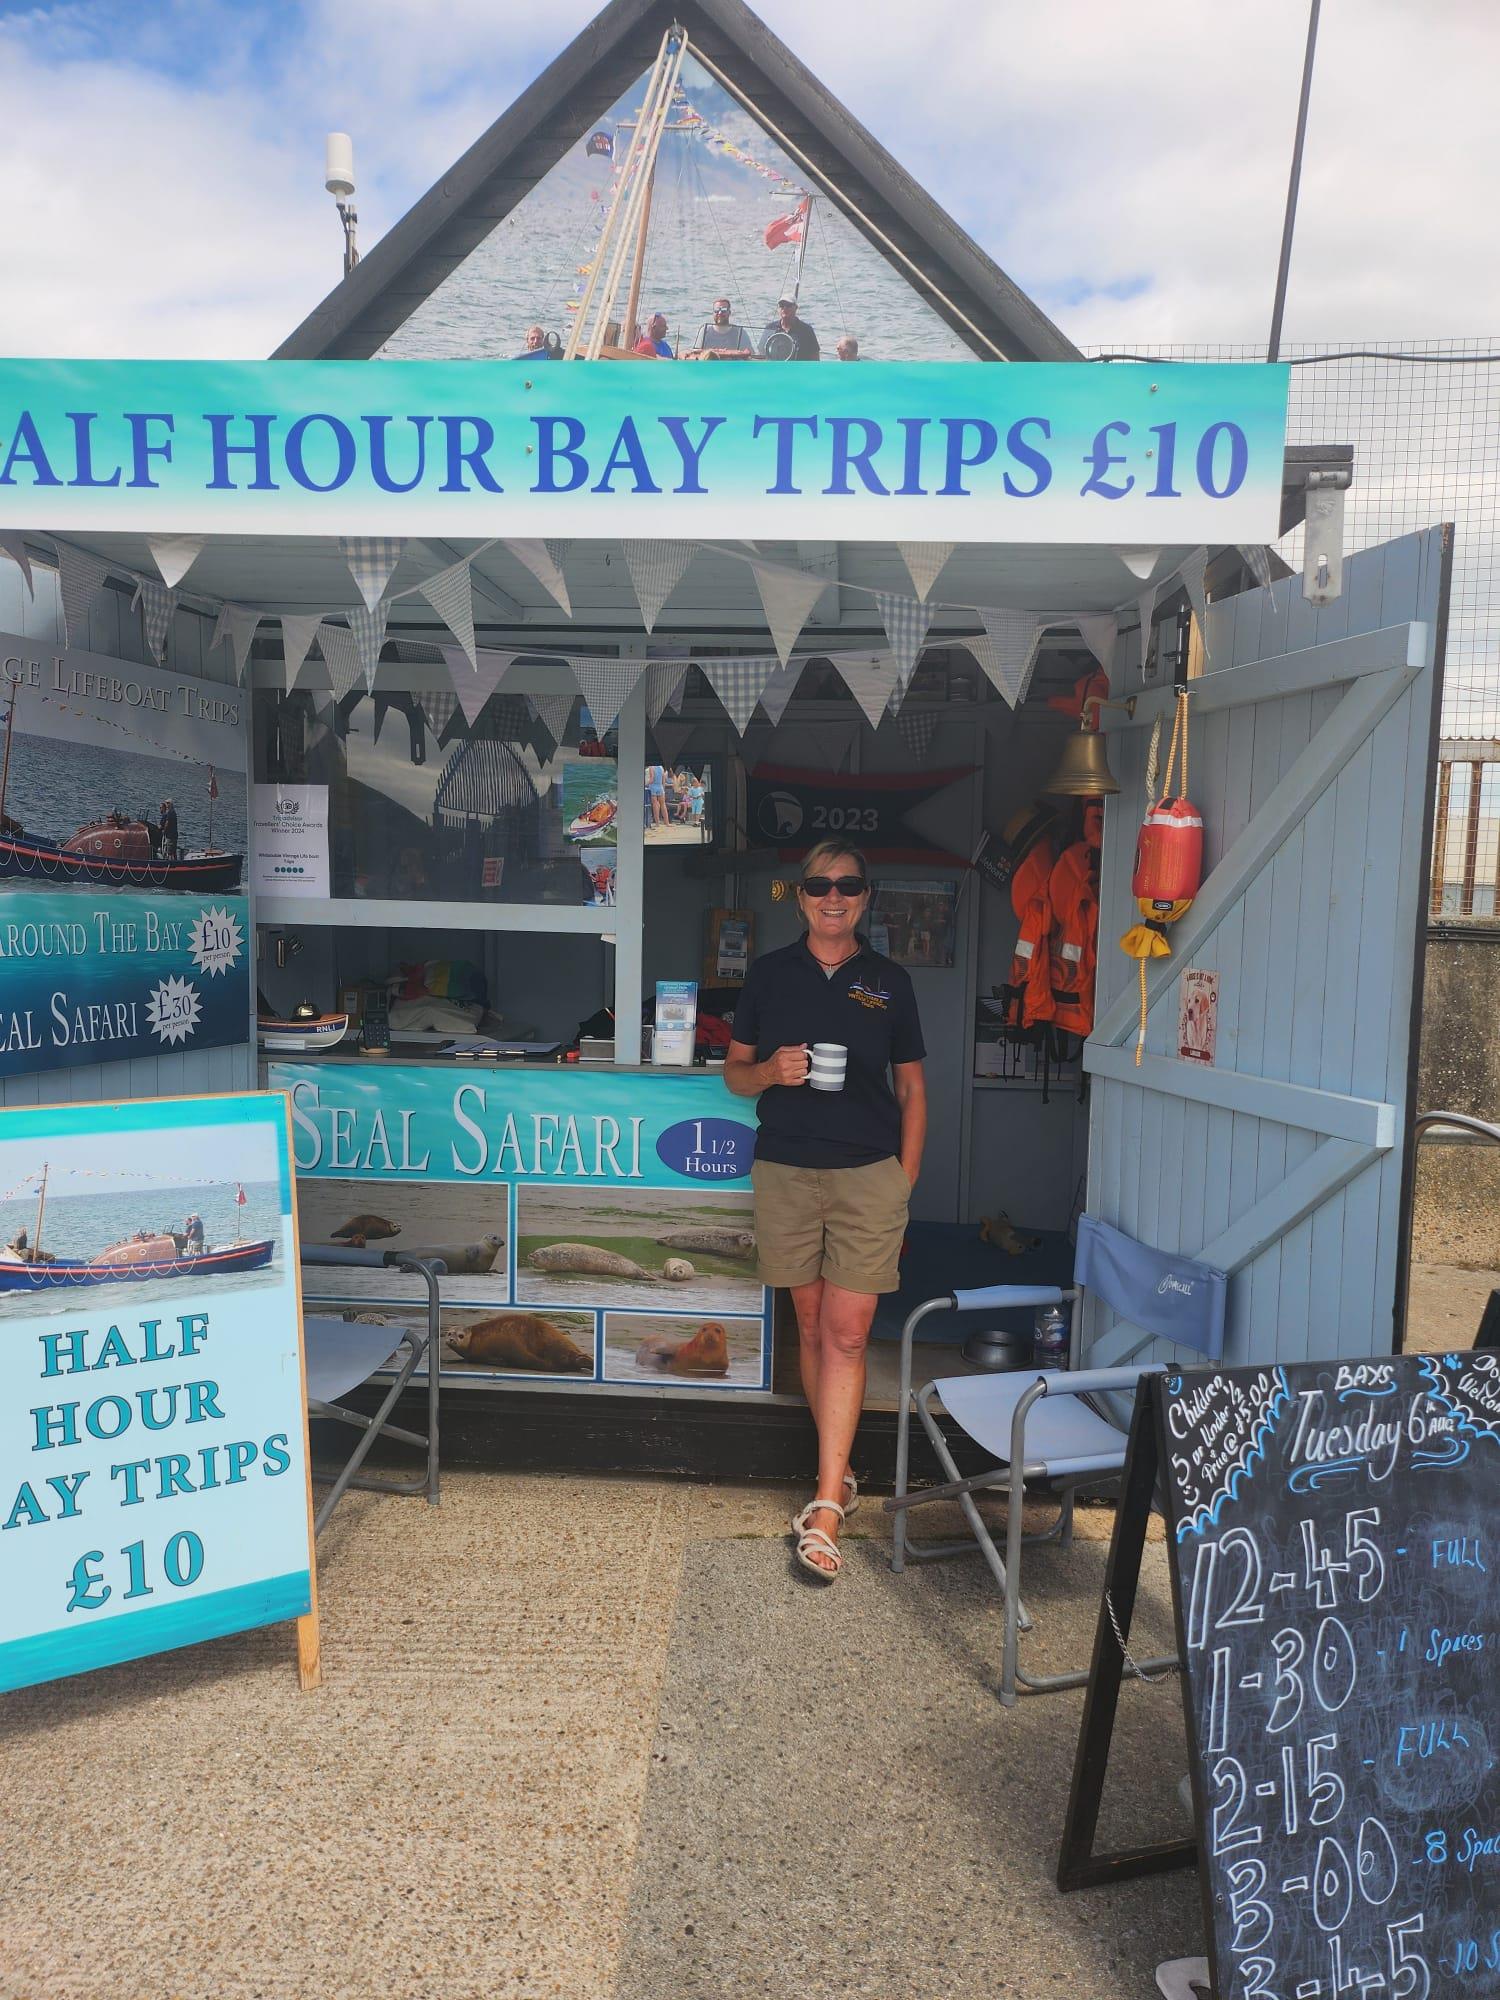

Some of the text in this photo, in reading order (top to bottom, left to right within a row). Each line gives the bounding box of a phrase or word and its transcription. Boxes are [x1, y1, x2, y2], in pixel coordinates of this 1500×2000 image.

[0, 409, 1249, 500] ALF HOUR BAY TRIPS £10
[0, 656, 41, 687] GE
[811, 806, 880, 832] 2023
[202, 920, 231, 953] £10
[203, 951, 231, 963] per person
[0, 1010, 42, 1051] AL
[158, 989, 192, 1022] £30
[162, 1018, 190, 1032] per person
[316, 1024, 336, 1034] RNLI
[684, 1156, 737, 1174] Hours
[691, 1121, 736, 1156] 1 1/2
[39, 1312, 210, 1379] HALF
[30, 1379, 226, 1453] HOUR
[1171, 1452, 1190, 1487] 5
[1192, 1445, 1204, 1466] or
[1200, 1405, 1230, 1448] Under
[1290, 1389, 1401, 1481] Tuesday
[1, 1433, 292, 1531] AY TRIPS
[65, 1530, 205, 1613] £10
[1187, 1506, 1385, 1651] 12-45
[1431, 1536, 1487, 1574] FULL
[1208, 1616, 1357, 1752] 1-30
[1212, 1733, 1346, 1857] 2-15
[1397, 1718, 1470, 1767] FULL
[1227, 1816, 1398, 1952] 3-00
